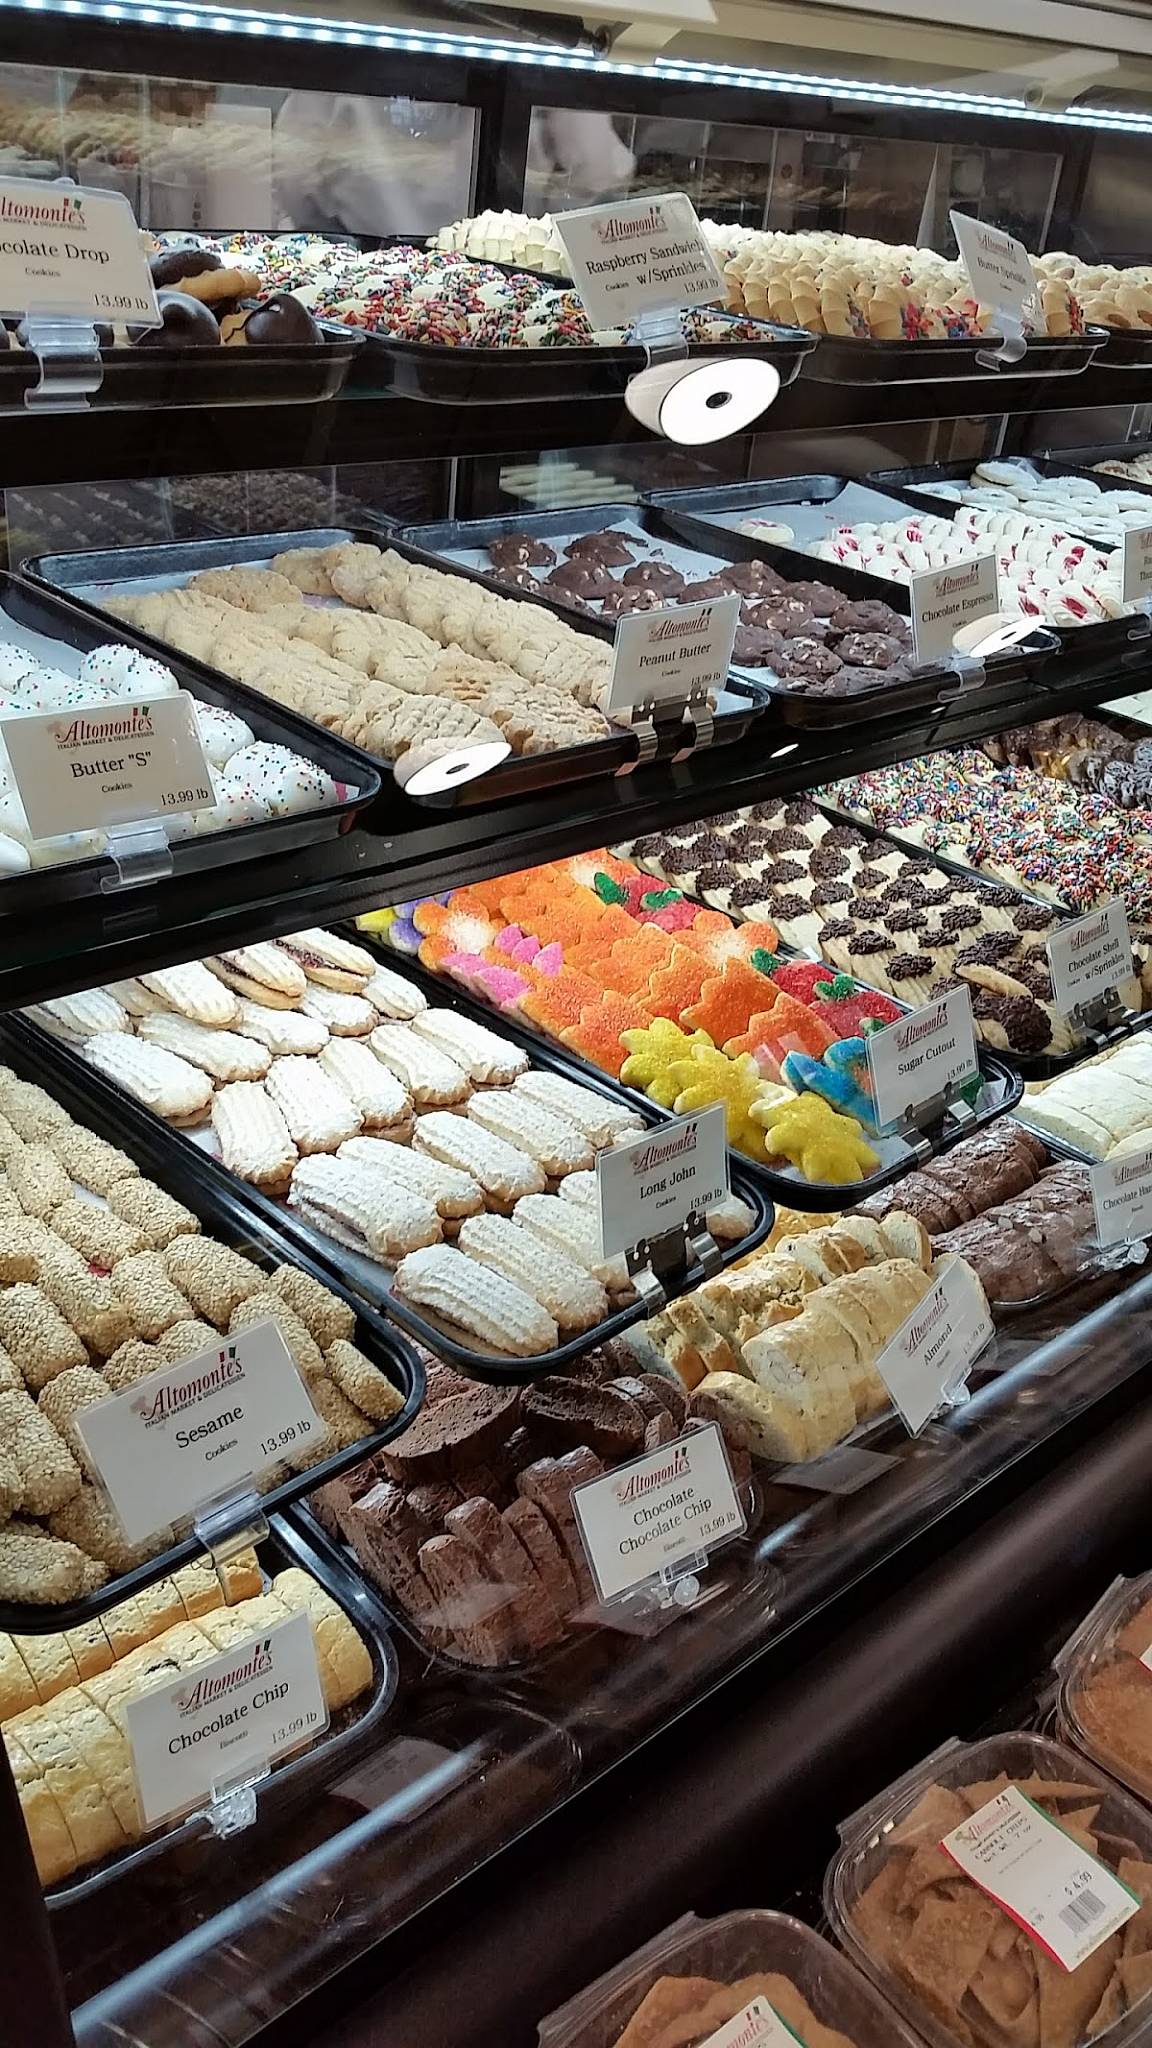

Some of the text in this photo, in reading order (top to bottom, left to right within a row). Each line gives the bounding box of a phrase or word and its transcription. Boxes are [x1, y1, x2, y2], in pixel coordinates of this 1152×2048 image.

[0, 196, 86, 224] ltomonte's
[0, 240, 110, 264] colate Drop
[585, 239, 705, 274] Raspberry Sandwich
[636, 261, 707, 285] w/Sprinkles
[94, 293, 149, 310] 13.99 lb
[921, 592, 994, 623] Chocolate Espresso
[639, 644, 712, 667] Peanut Butter
[54, 706, 153, 743] Altomonte's
[70, 751, 152, 779] Butter "S"
[101, 781, 133, 793] Cookies
[161, 788, 209, 806] 13.99 lb
[1068, 950, 1101, 973] Chocolate
[1084, 953, 1125, 980] w/Sprinkles
[898, 1037, 956, 1076] Sugar Cutout
[633, 1122, 697, 1170] Altomonte's
[640, 1166, 696, 1199] Long John
[690, 1188, 722, 1210] 13.99 lb
[1103, 1191, 1138, 1210] Chocolate
[923, 1323, 953, 1366] Almond
[140, 1345, 243, 1420] Altomonte's
[175, 1406, 245, 1449] Sesame
[260, 1420, 312, 1456] 13.99 lb
[204, 1439, 239, 1461] Cookies
[617, 1447, 690, 1501] Altomonte's
[633, 1487, 695, 1526] Chocolate
[619, 1498, 712, 1555] Chocolate Chip
[699, 1511, 736, 1537] 13.99 lb
[178, 1639, 272, 1711] Altomonte's
[168, 1682, 290, 1755] Chocolate Chip
[271, 1711, 318, 1744] 13.99 lb
